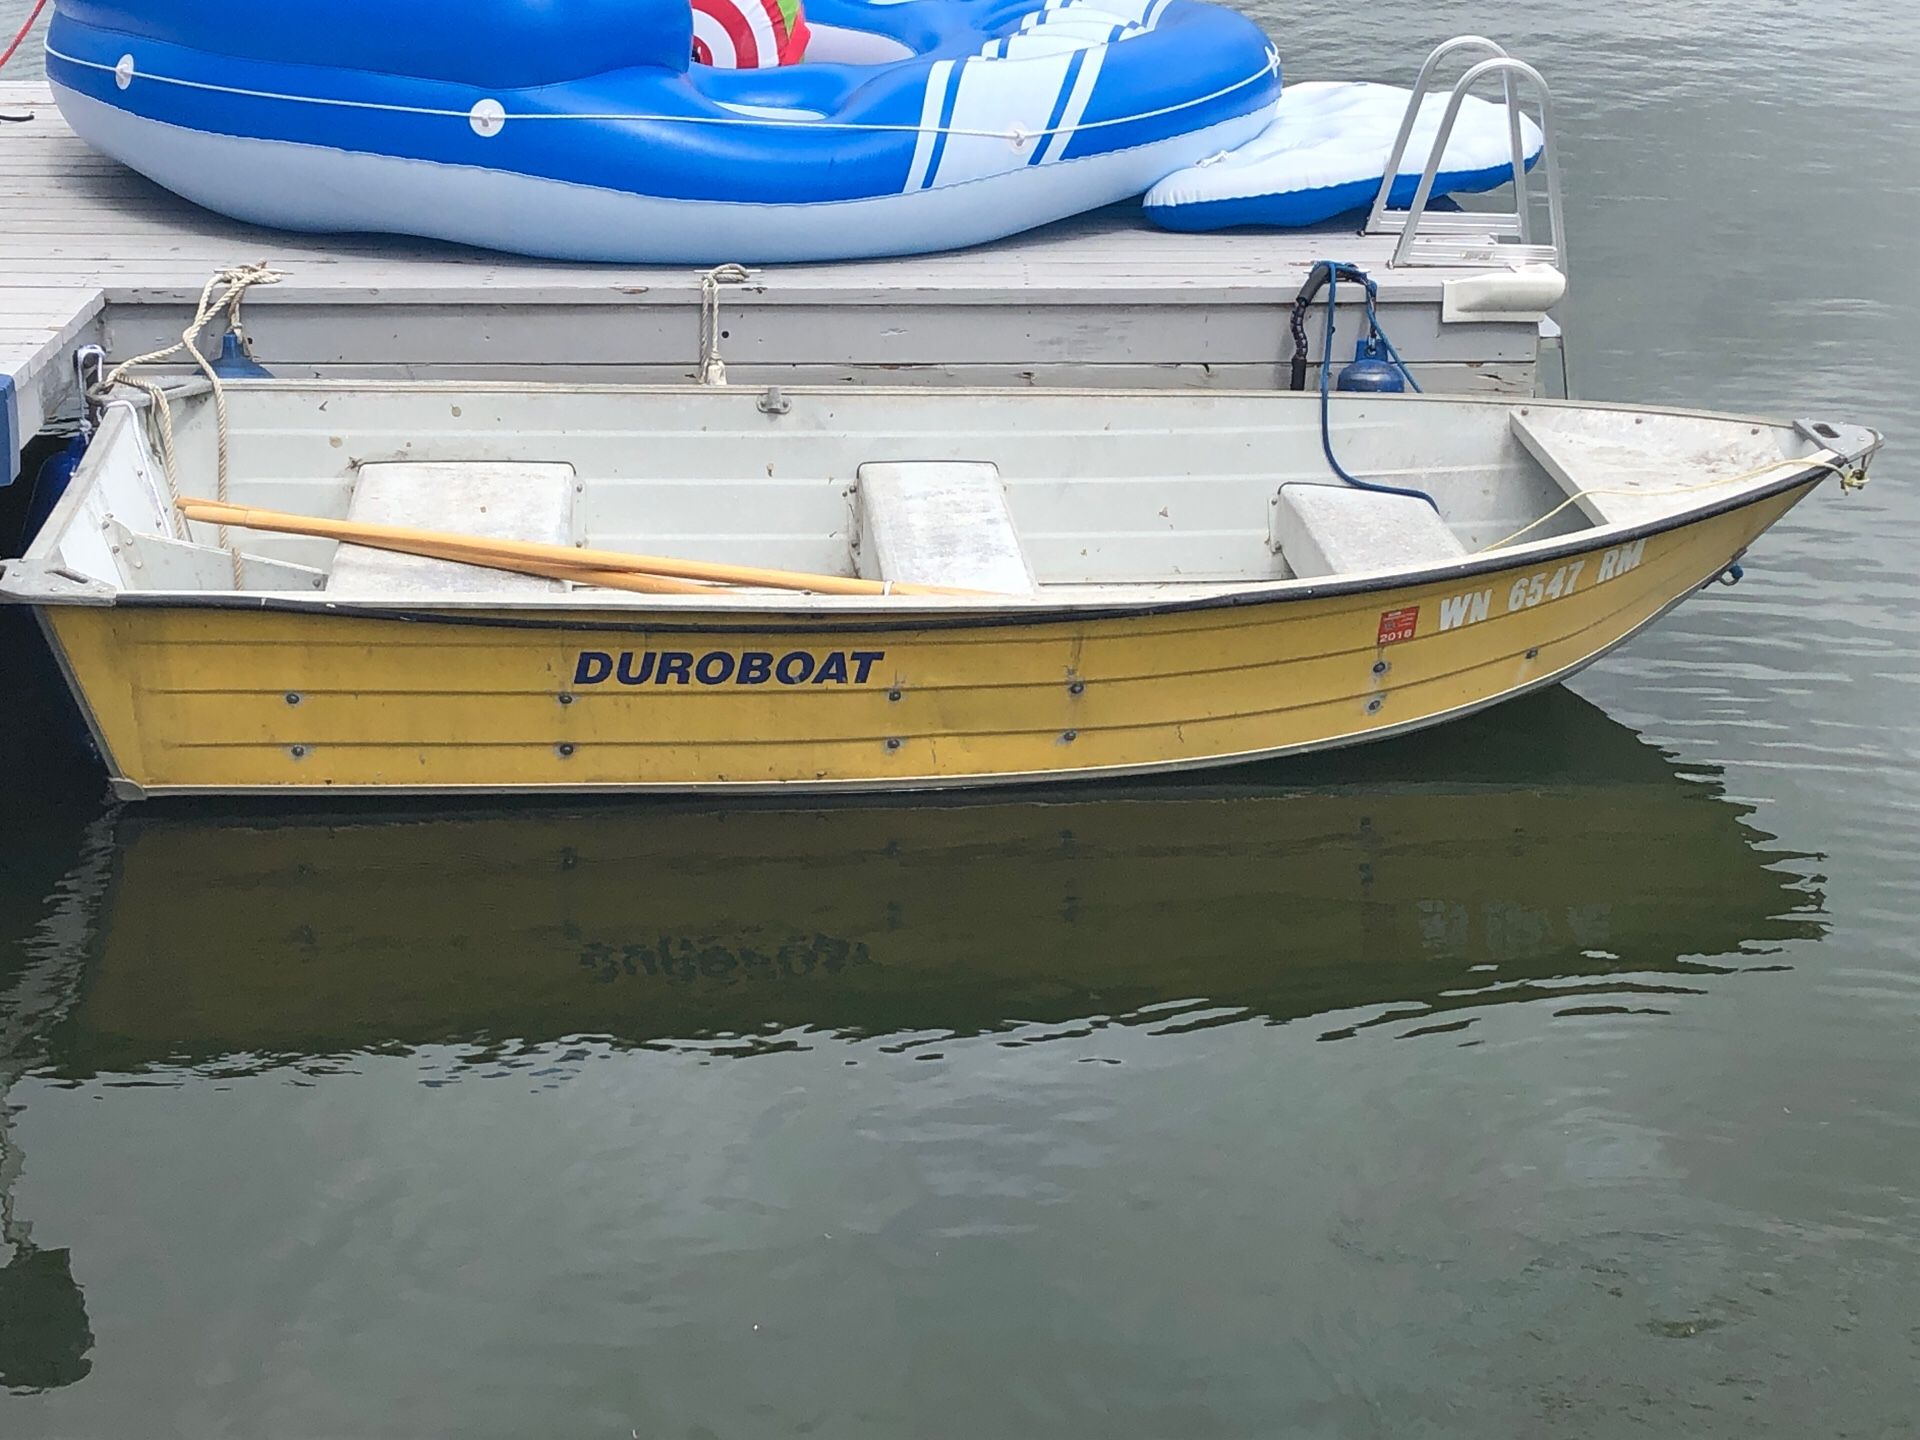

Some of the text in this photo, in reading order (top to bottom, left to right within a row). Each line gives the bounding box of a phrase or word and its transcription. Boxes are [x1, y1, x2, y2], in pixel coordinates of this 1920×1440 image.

[1439, 538, 1647, 631] WN 6547 RM
[574, 651, 885, 685] DUROBOAT
